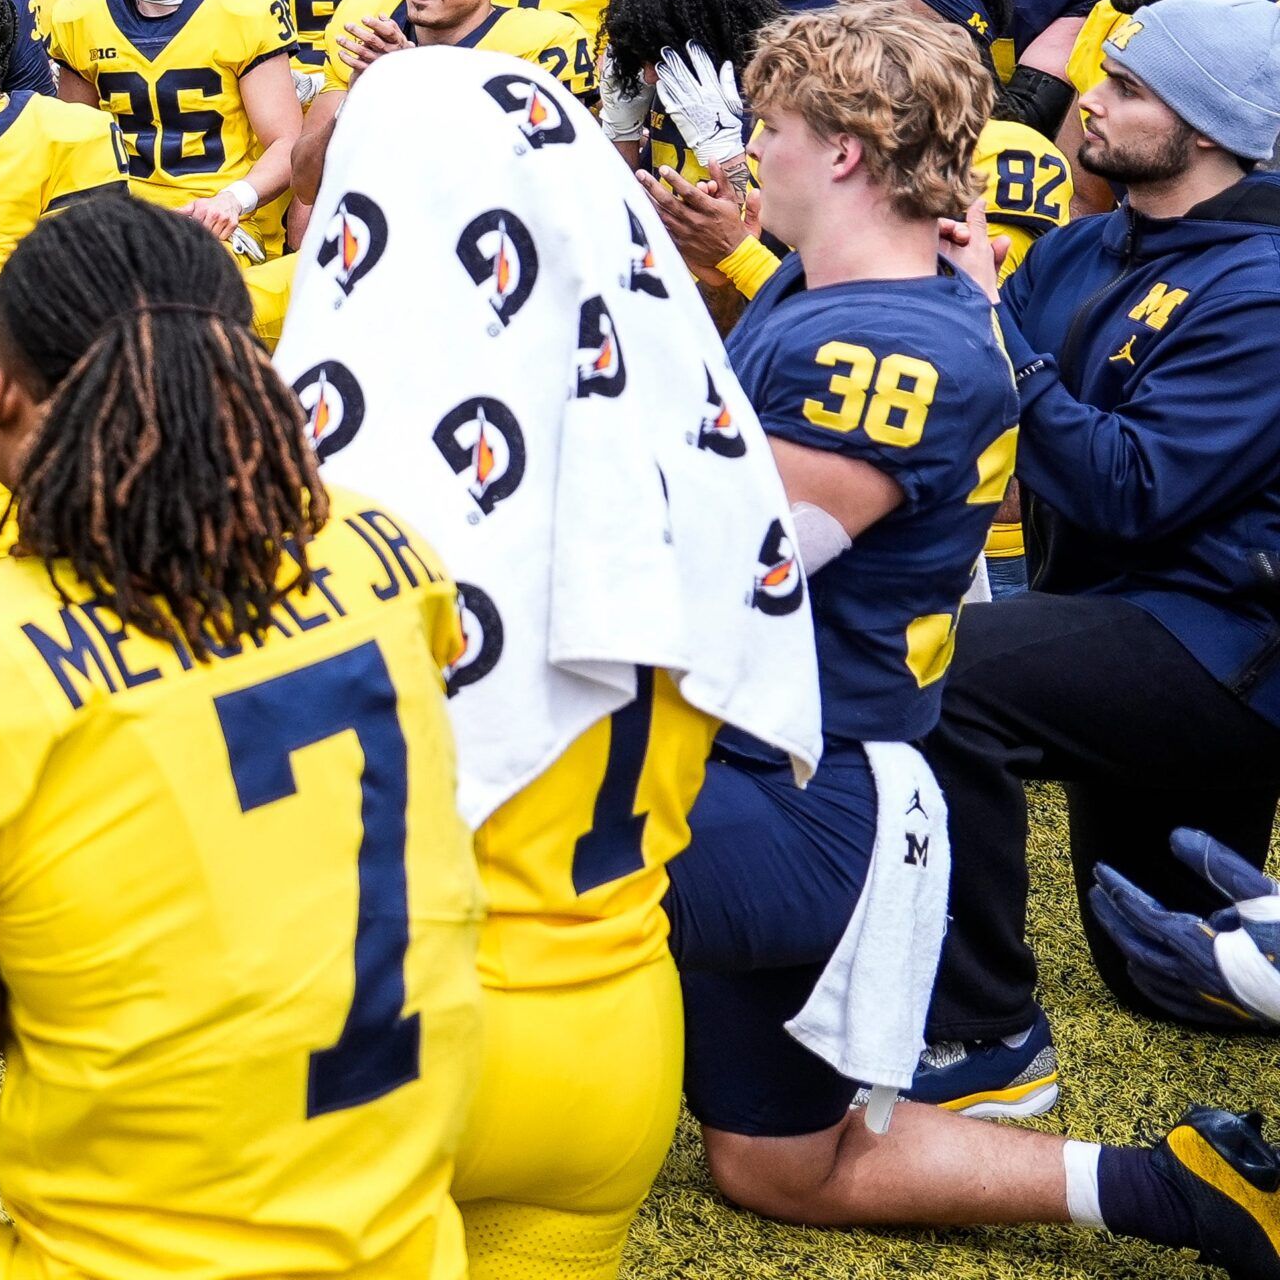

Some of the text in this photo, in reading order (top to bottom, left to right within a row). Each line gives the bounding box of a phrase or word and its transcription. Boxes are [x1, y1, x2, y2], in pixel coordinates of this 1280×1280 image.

[967, 12, 989, 34] M
[1109, 21, 1145, 52] M
[97, 67, 226, 179] 36
[995, 149, 1068, 220] 82
[1128, 282, 1190, 332] M
[802, 340, 939, 449] 38
[212, 637, 421, 1120] 7
[902, 831, 931, 869] M
